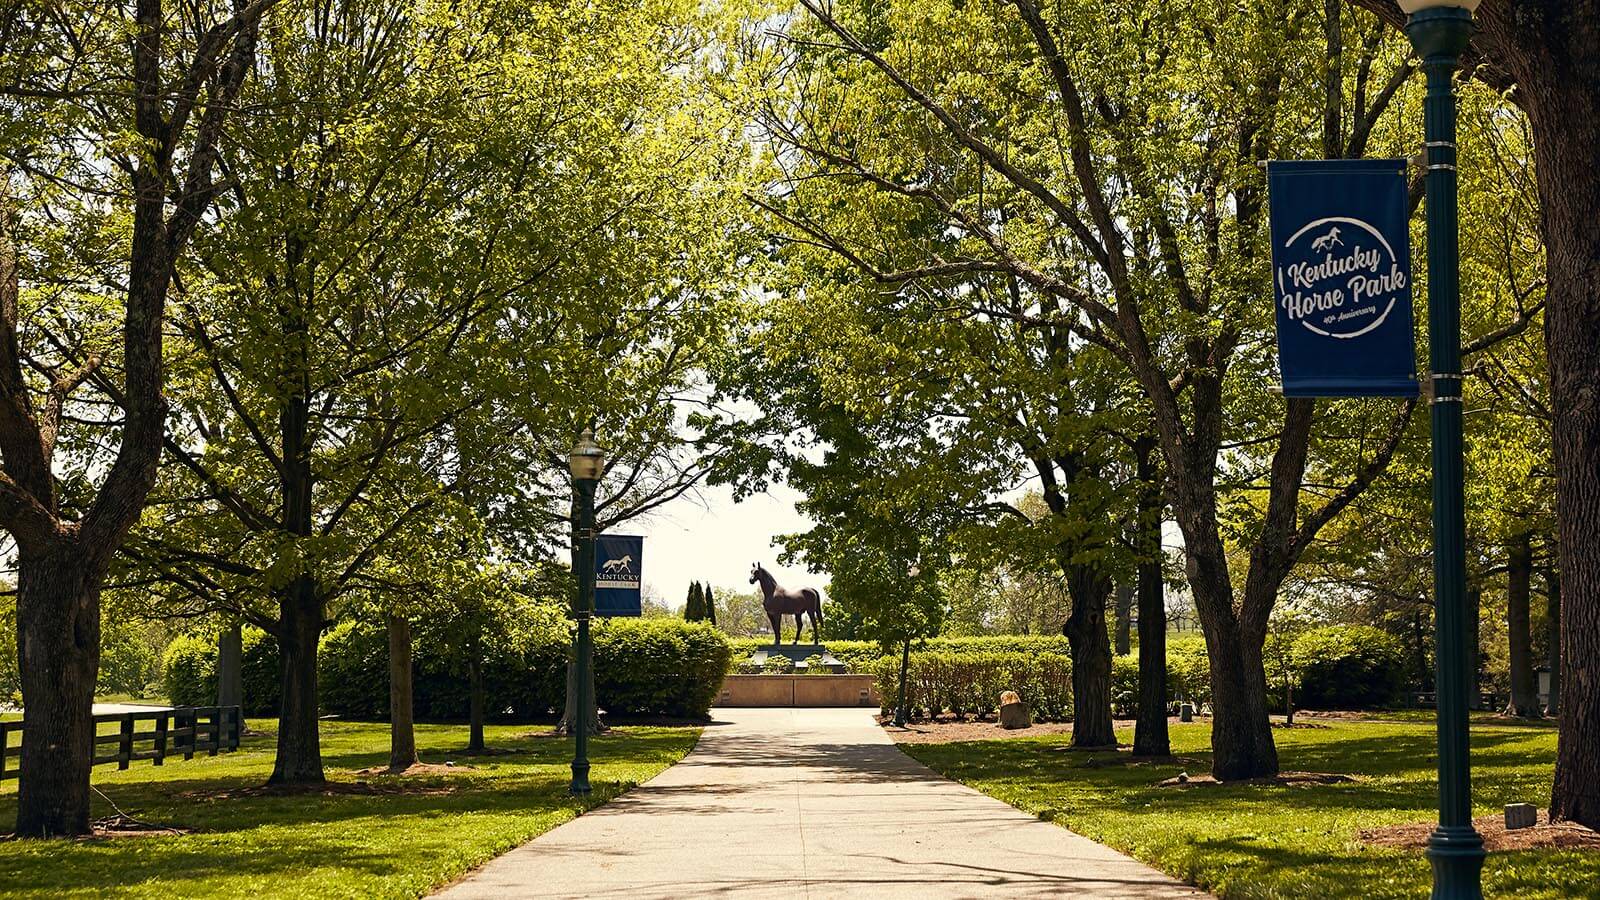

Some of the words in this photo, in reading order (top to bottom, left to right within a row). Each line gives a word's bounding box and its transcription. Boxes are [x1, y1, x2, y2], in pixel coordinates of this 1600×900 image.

[1281, 289, 1344, 319] Horse
[1347, 263, 1406, 303] Park
[1288, 245, 1380, 288] Kentucky
